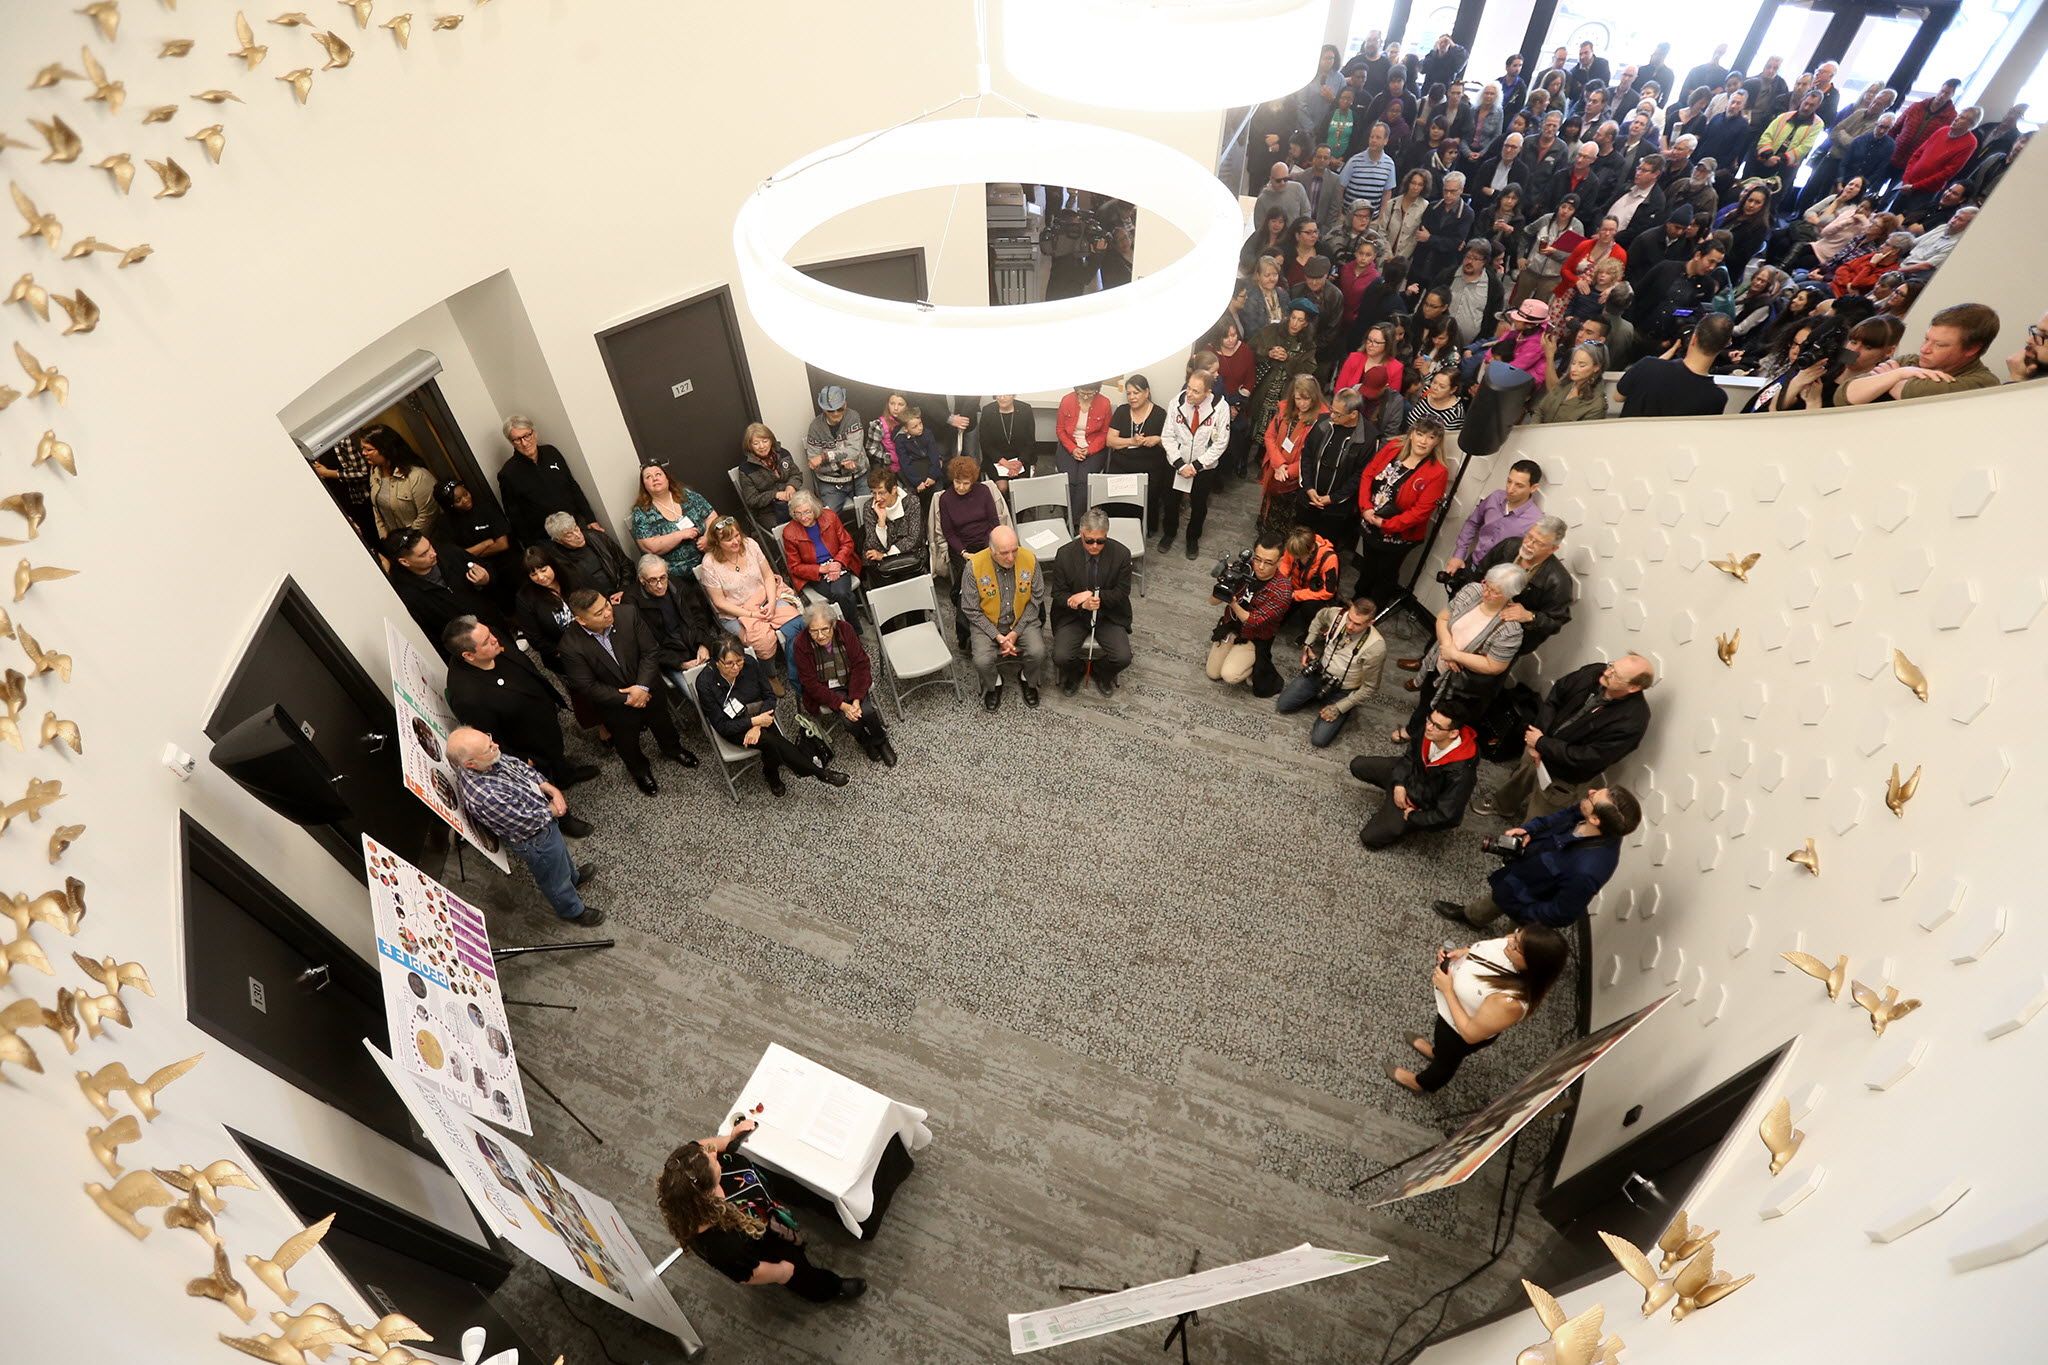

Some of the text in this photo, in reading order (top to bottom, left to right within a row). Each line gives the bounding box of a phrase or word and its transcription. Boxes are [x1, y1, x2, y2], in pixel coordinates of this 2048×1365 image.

[675, 382, 689, 395] 127
[396, 948, 448, 987] PEOPLE
[252, 983, 263, 1005] 130
